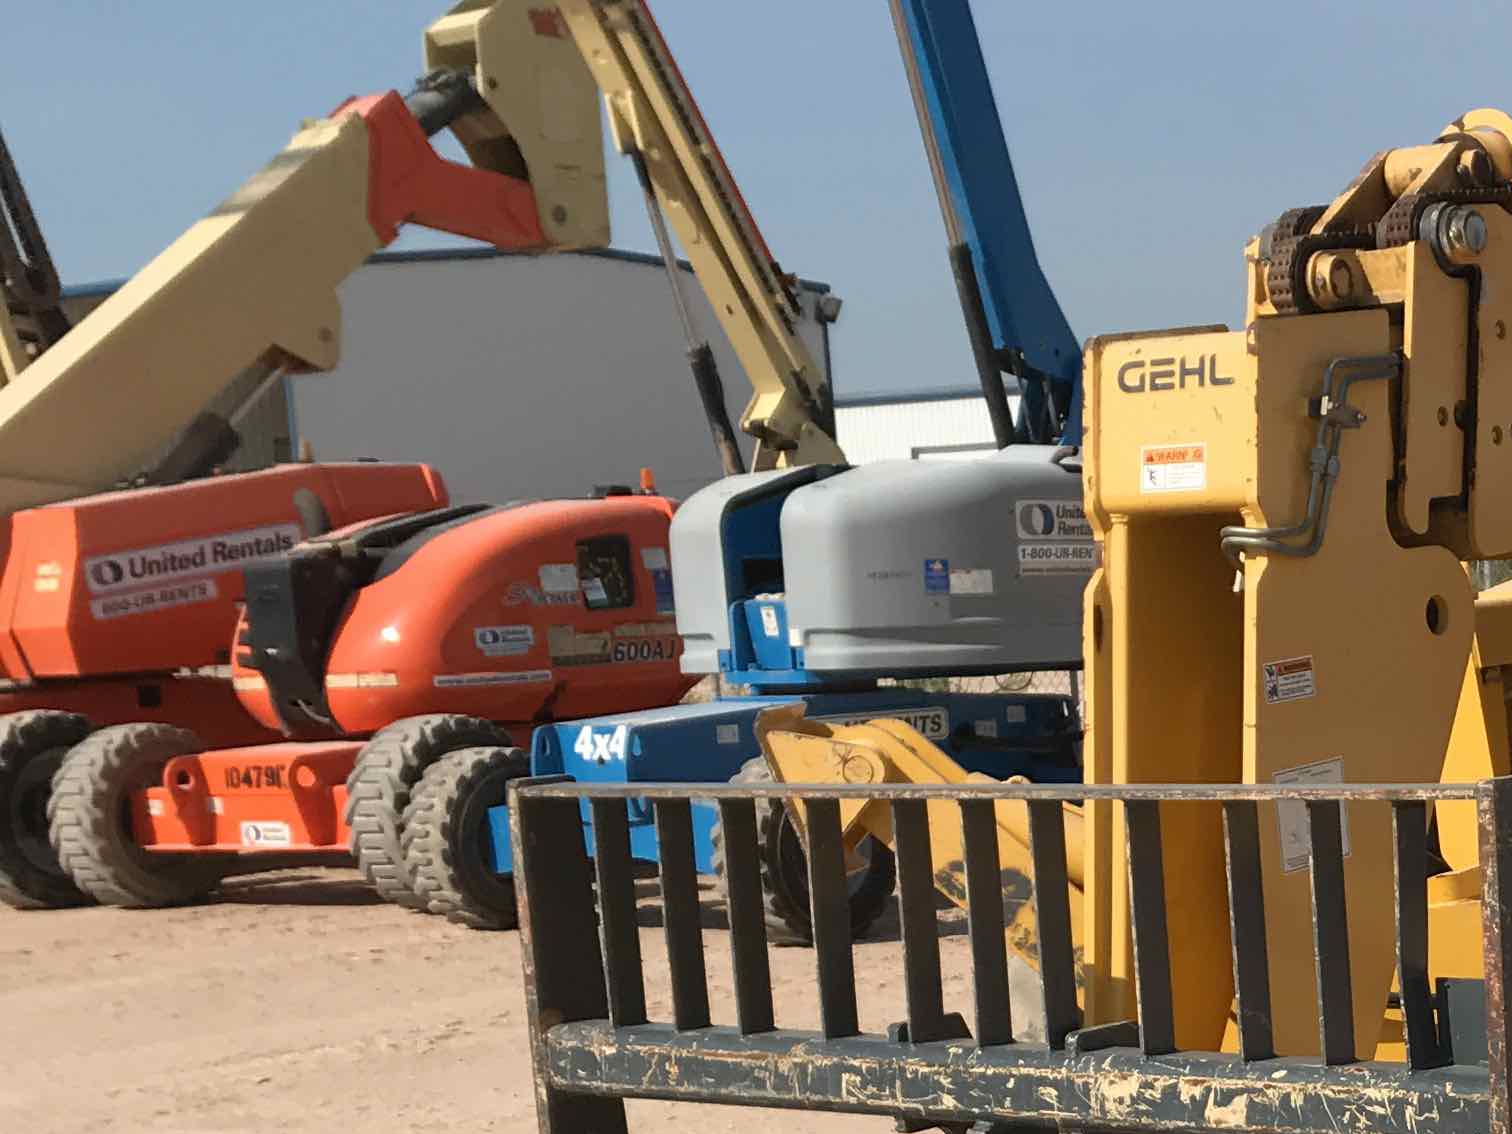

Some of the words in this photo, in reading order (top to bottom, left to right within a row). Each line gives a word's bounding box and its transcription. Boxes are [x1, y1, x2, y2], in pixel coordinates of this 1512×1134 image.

[1118, 352, 1235, 393] GEHL
[1056, 504, 1086, 519] Unite
[1058, 521, 1094, 536] Renta
[128, 544, 206, 578] United
[211, 532, 293, 563] Rentals
[613, 640, 675, 662] 600AJ
[574, 725, 627, 761] 4x4
